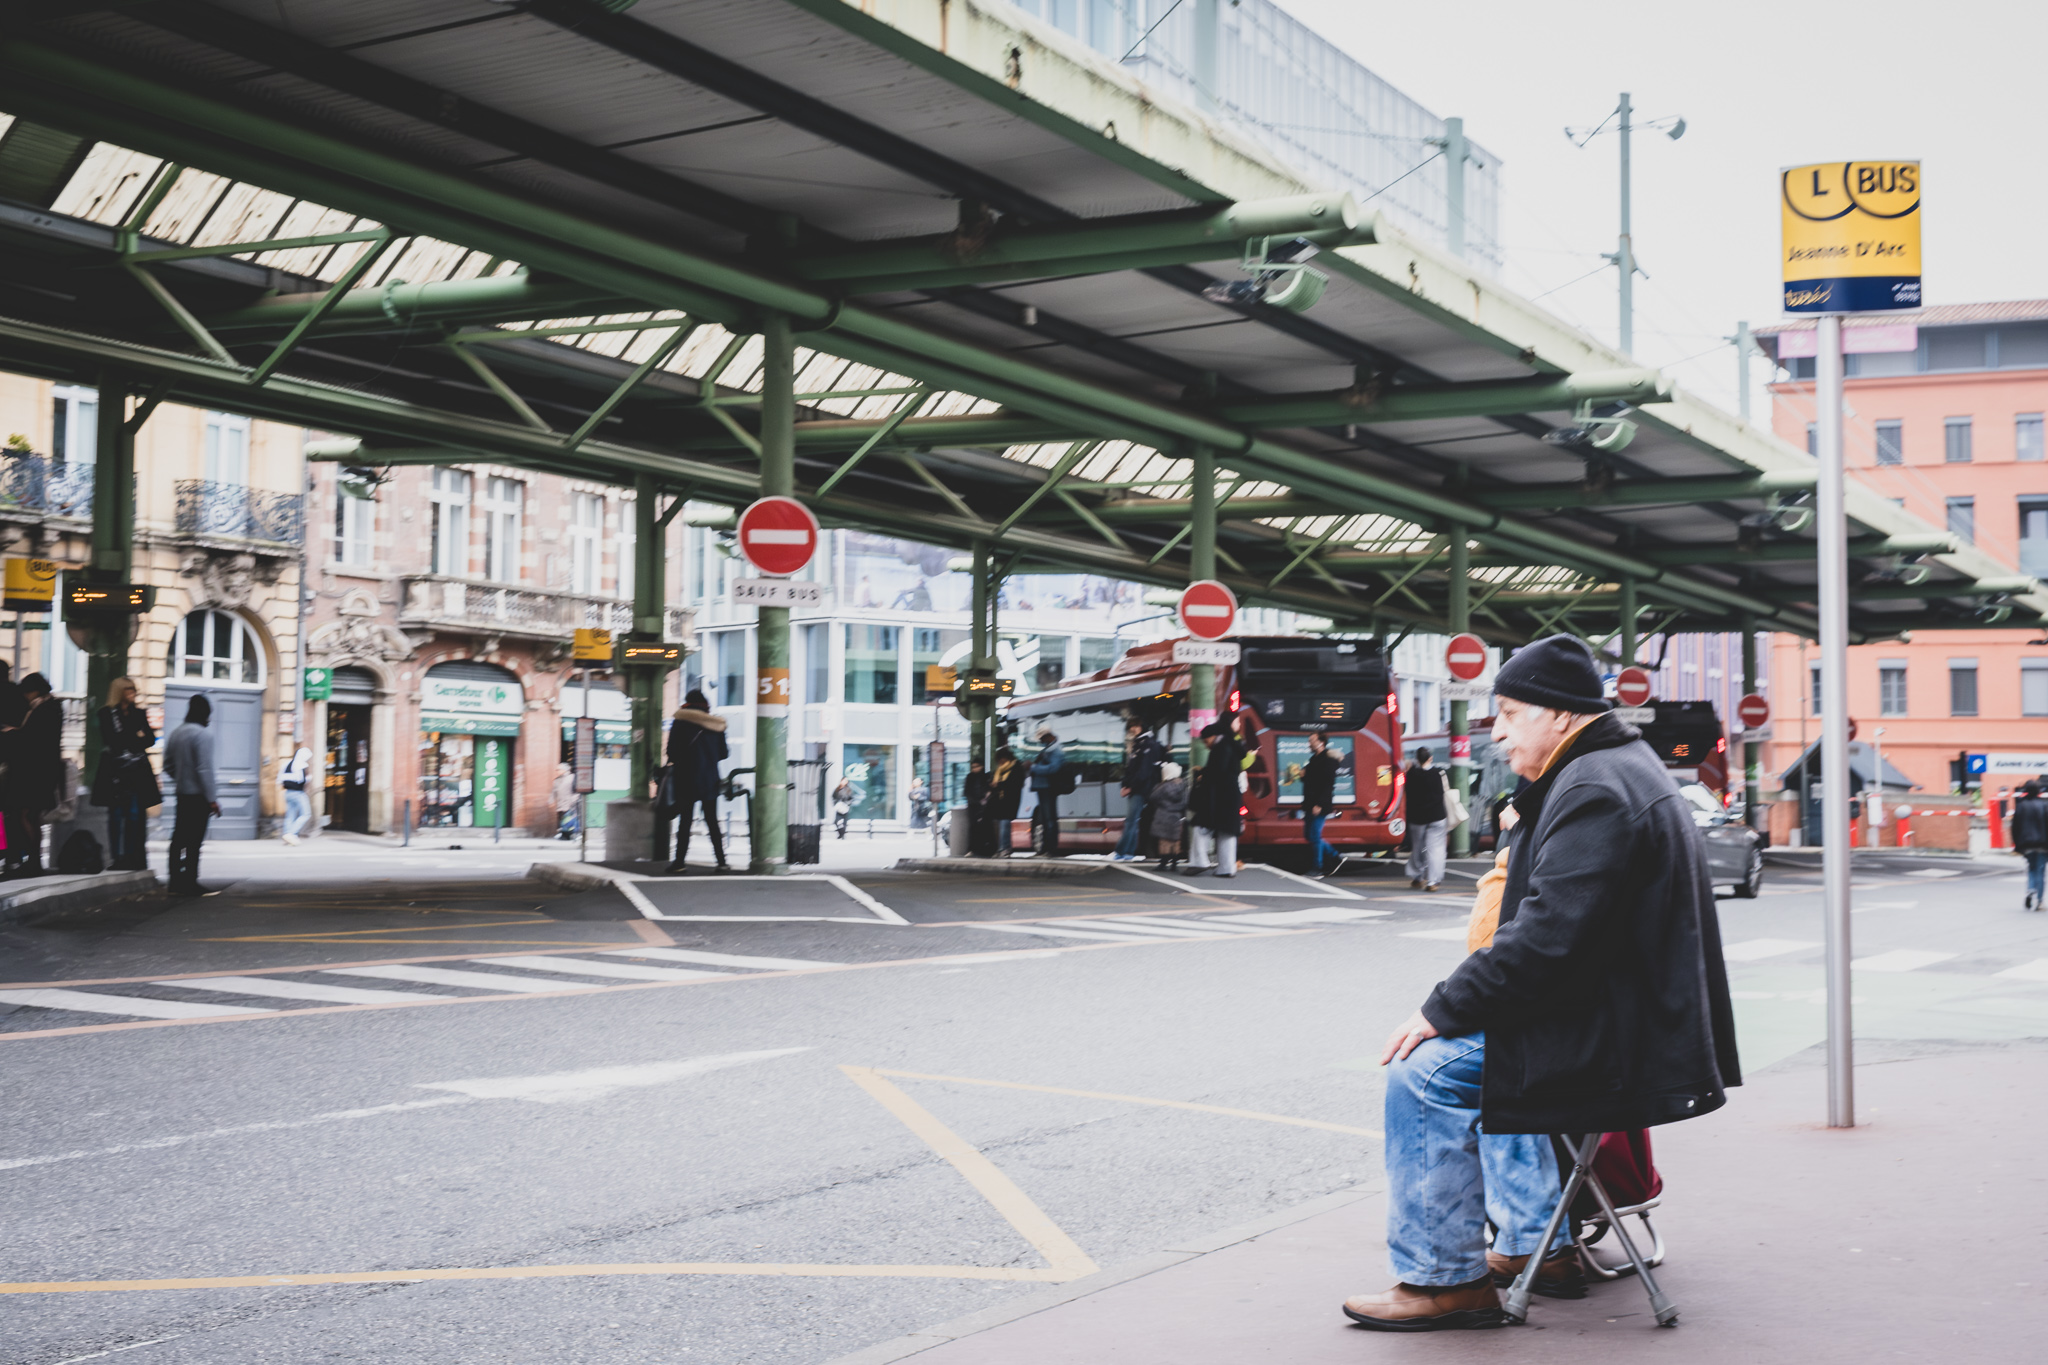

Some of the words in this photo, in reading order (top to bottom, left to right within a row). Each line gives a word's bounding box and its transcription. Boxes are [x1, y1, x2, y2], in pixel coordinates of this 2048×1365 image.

[1812, 168, 1830, 197] L
[1857, 165, 1917, 194] BUS
[1787, 245, 1850, 262] Jeanne
[735, 584, 779, 599] SAUF
[787, 587, 819, 601] BUS
[1176, 647, 1208, 658] SAUF
